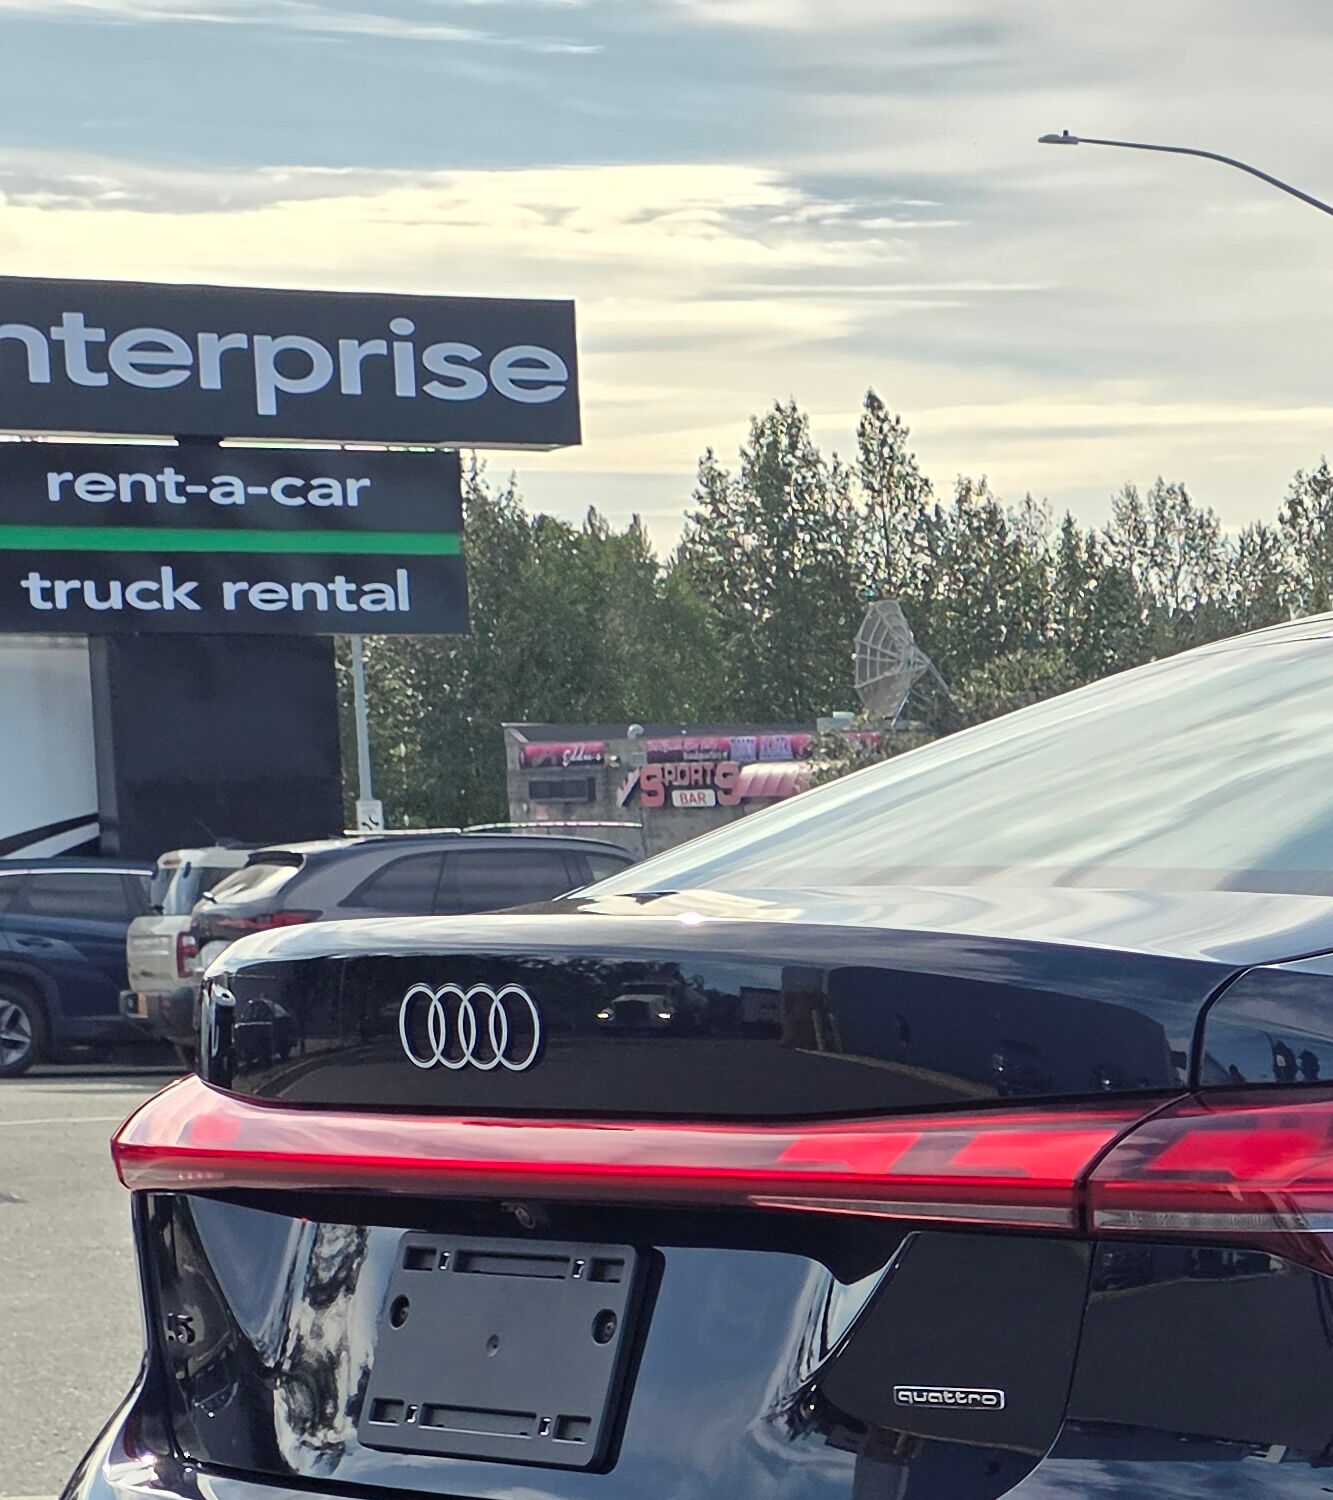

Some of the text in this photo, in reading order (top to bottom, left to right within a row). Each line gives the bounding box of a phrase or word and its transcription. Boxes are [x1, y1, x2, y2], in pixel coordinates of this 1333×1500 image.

[46, 465, 372, 508] rent-a-car
[20, 564, 410, 613] truck rental
[640, 762, 741, 807] SPORTS
[680, 793, 706, 805] BAR
[897, 1390, 998, 1405] quattro
